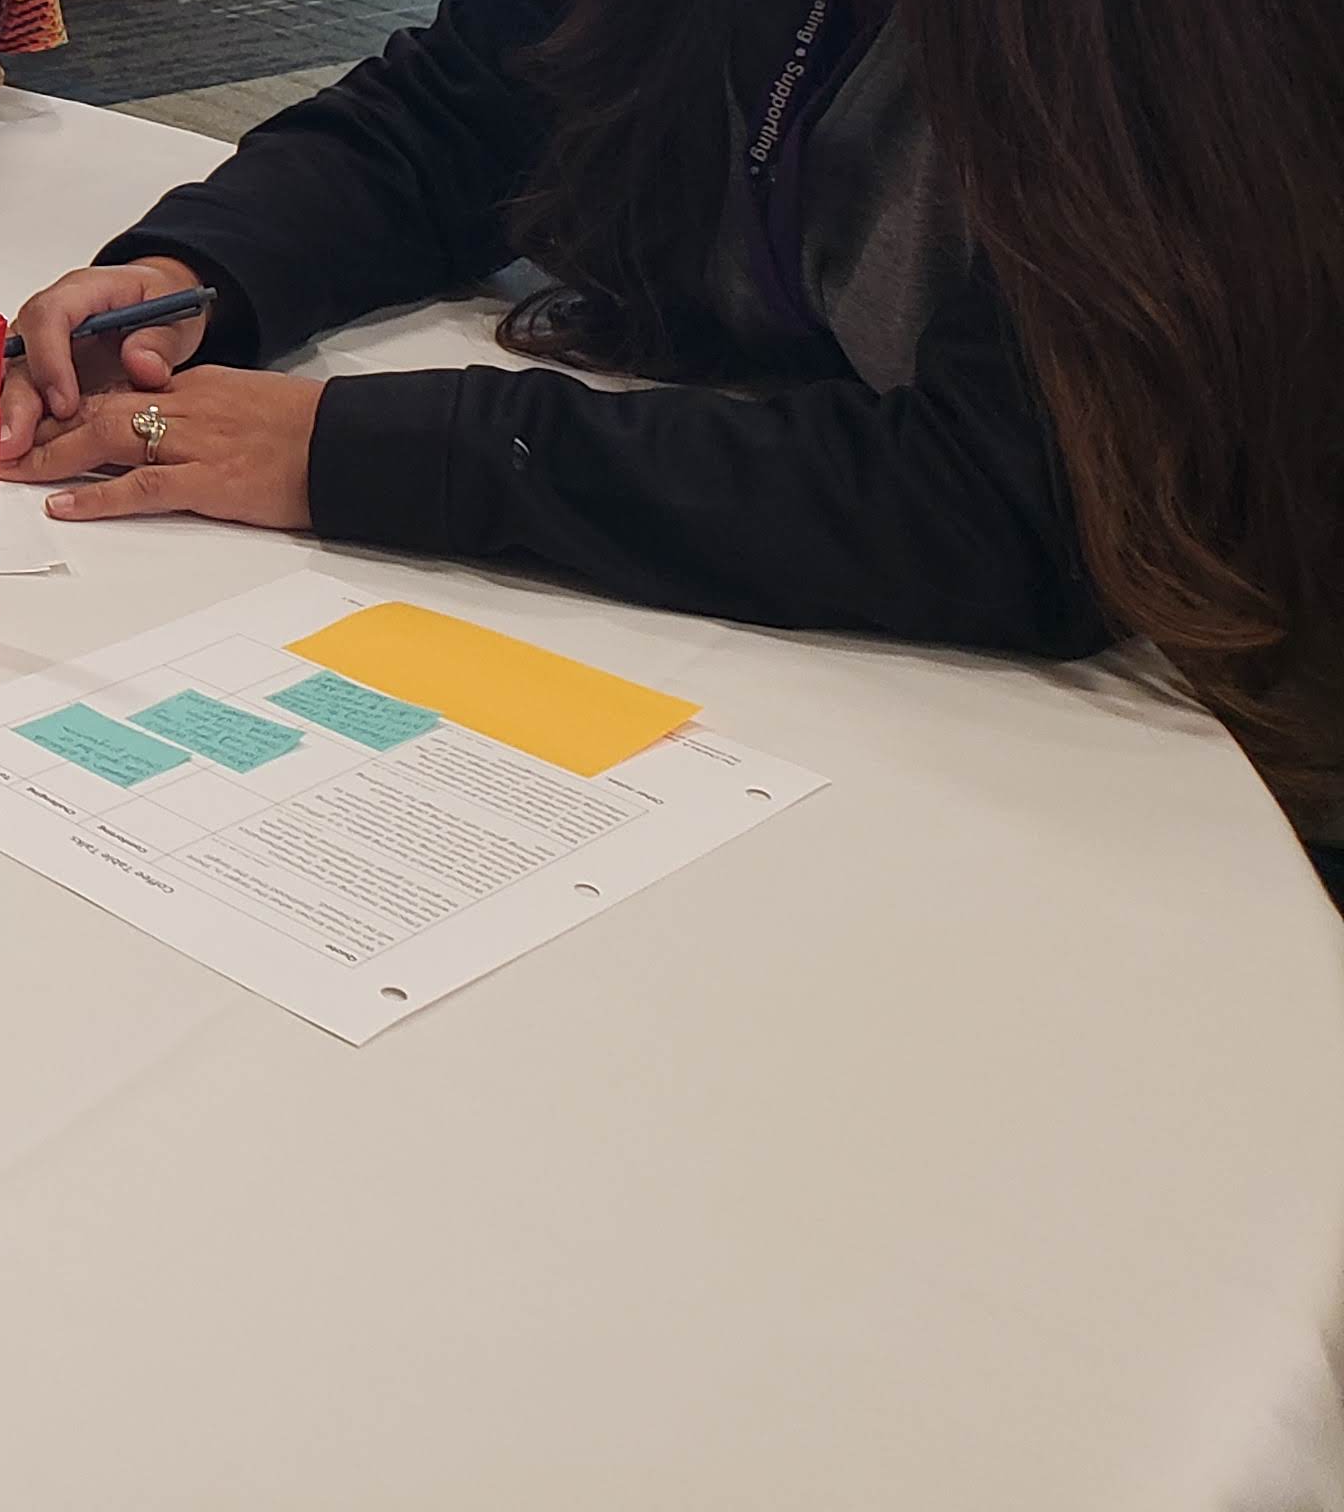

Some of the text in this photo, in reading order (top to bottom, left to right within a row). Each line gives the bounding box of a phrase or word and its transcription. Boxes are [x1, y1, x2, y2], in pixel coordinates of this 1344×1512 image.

[750, 60, 804, 162] Supporting
[70, 835, 175, 895] Coffee Table Talks
